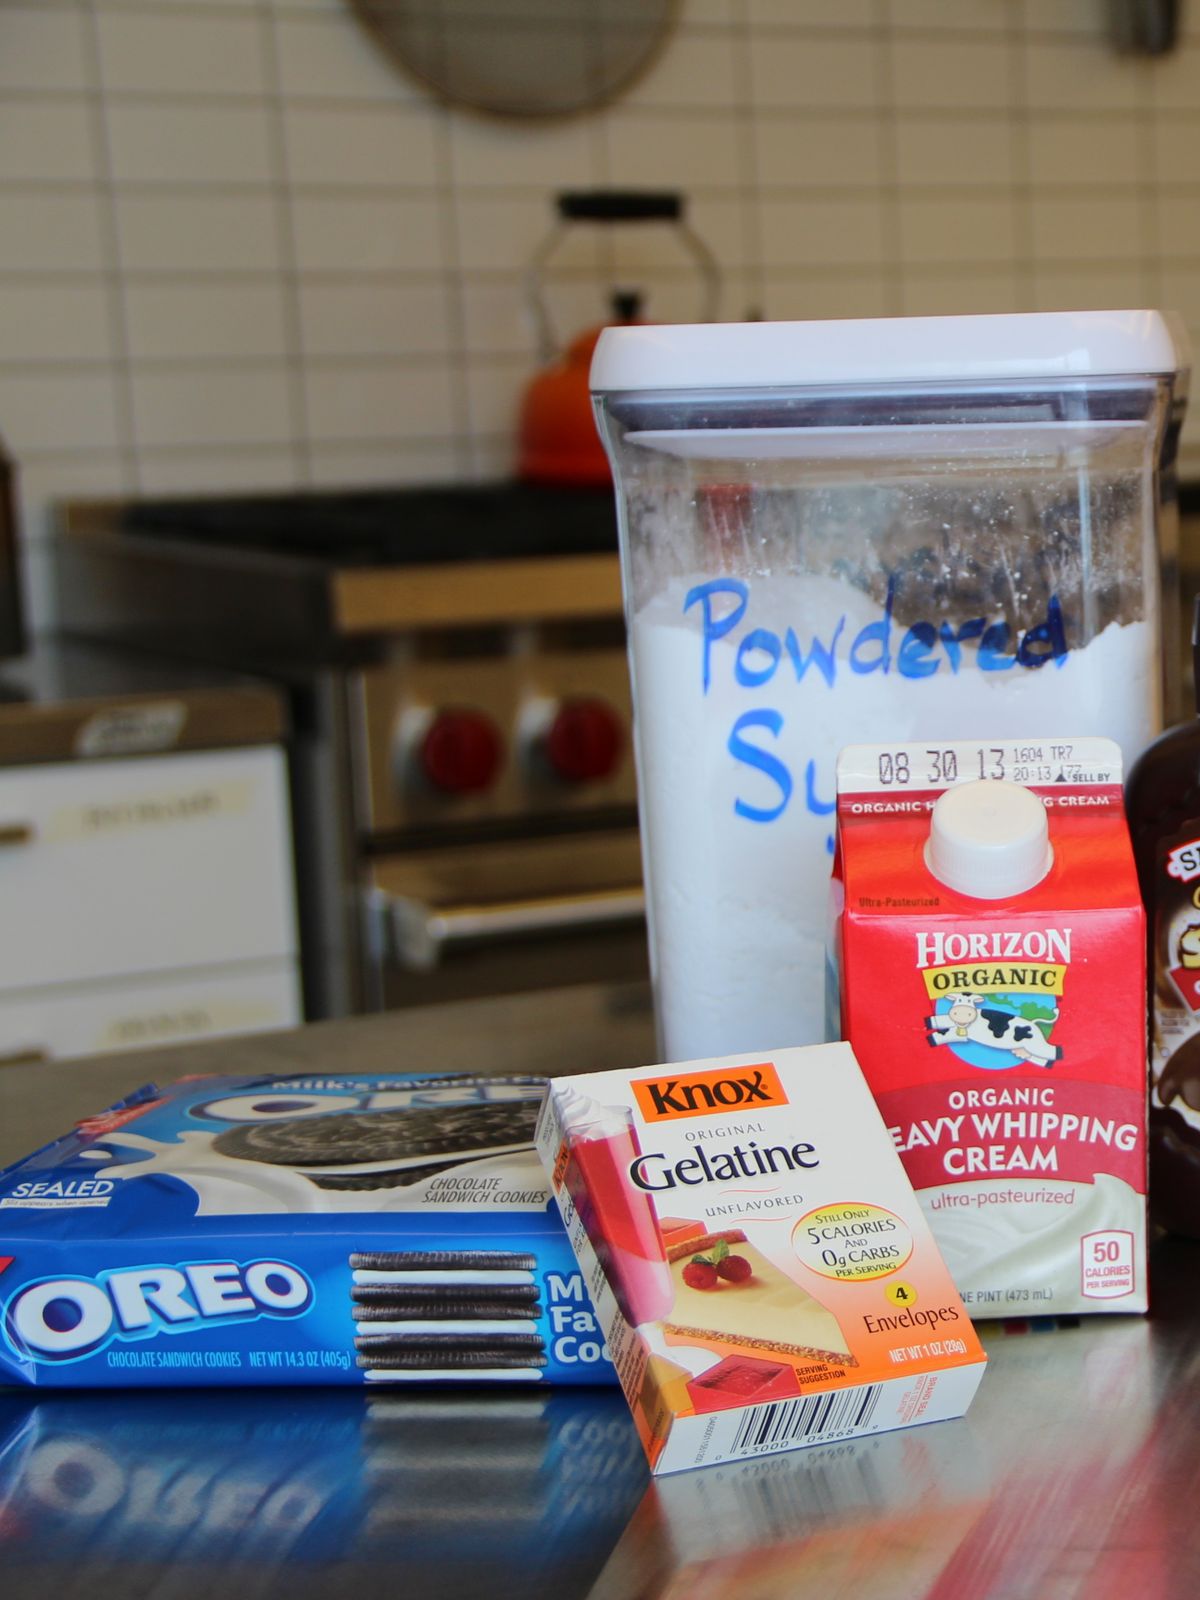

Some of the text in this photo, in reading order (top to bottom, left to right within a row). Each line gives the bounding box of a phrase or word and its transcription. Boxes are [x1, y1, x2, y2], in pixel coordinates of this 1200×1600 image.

[683, 573, 1068, 695] Powdered
[1013, 745, 1073, 763] 1604 TR7
[727, 708, 837, 825] Su
[879, 749, 1005, 784] 08 30 13
[1072, 773, 1110, 782] SELL BY
[851, 801, 922, 814] ORGANIC
[1058, 796, 1110, 806] CREAM
[915, 928, 1072, 968] HORIZON
[932, 968, 1057, 990] ORGANIC
[645, 1070, 774, 1115] Knox
[948, 1087, 1055, 1109] ORGANIC
[685, 1122, 765, 1142] ORIGINAL
[889, 1112, 1138, 1153] EAVY WHIPPING
[630, 1141, 820, 1192] Gelatine
[943, 1145, 1059, 1175] CREAM
[12, 1180, 114, 1198] SEALED
[430, 1178, 502, 1190] CHOCOLATE
[422, 1191, 547, 1203] SANDWICH COOKIES
[705, 1193, 804, 1217] UNFLAVORED
[930, 1188, 1075, 1210] ultra-pasteurized
[815, 1209, 870, 1225] STILL ONLY
[807, 1218, 896, 1245] 5 CALORIES
[844, 1238, 868, 1249] AND
[1093, 1241, 1119, 1262] 50
[822, 1244, 900, 1268] 0g CARBS
[835, 1262, 897, 1278] PER SERVING
[1085, 1265, 1130, 1278] CALORIES
[547, 1274, 584, 1301] M
[895, 1287, 908, 1300] 4
[960, 1289, 1053, 1303] NE PINT (473 mL)
[13, 1263, 308, 1353] OREO
[550, 1306, 596, 1333] Fa
[863, 1306, 959, 1334] Envelopes
[107, 1351, 242, 1367] CHOCOLATE SANDWICH COOKIES
[250, 1350, 351, 1370] NET WT 14.3 OZ (405g)
[889, 1338, 967, 1363] NET WT 1 OZ (28g)
[796, 1364, 828, 1376] SERVING
[799, 1369, 846, 1385] SUGGESTION
